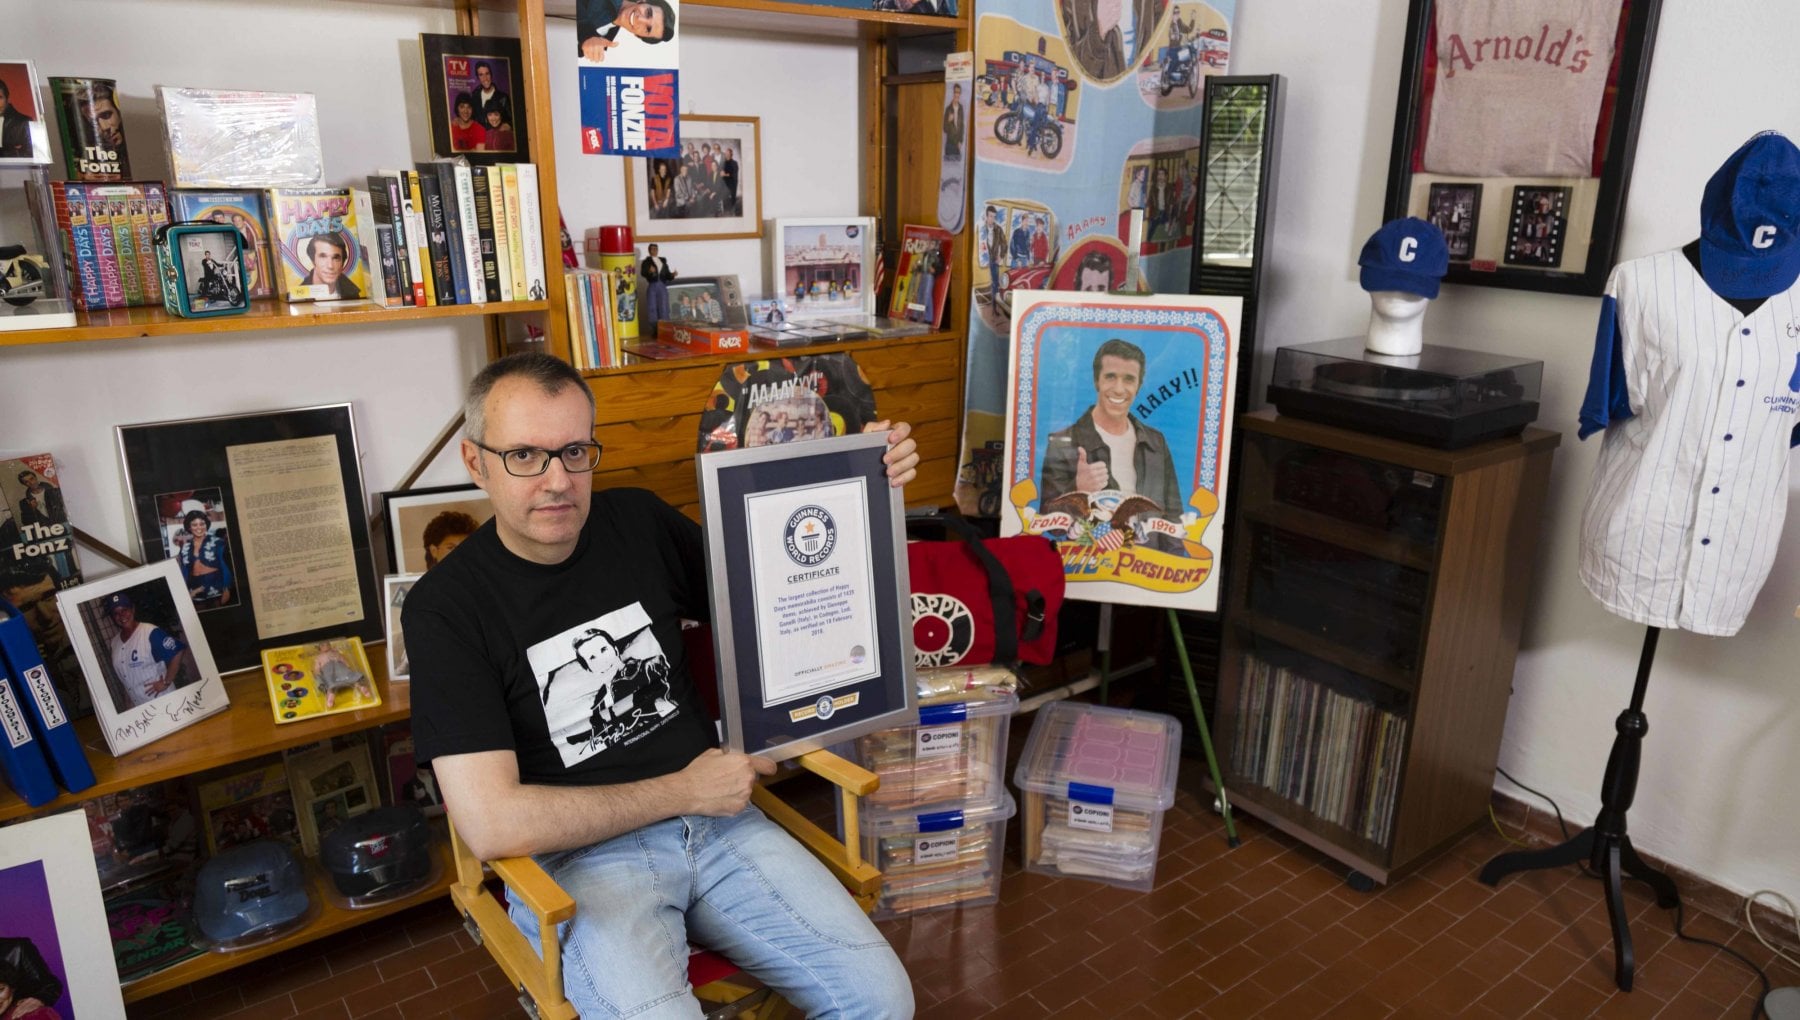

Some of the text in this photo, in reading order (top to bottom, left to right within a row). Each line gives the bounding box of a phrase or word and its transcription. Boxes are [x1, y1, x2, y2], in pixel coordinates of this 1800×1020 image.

[1446, 24, 1593, 78] Arnold's
[449, 60, 468, 71] TV
[620, 76, 647, 151] FONZIE
[643, 73, 675, 150] VOTA
[588, 129, 601, 150] FOX
[85, 145, 117, 161] The
[79, 159, 121, 174] Fonz
[282, 196, 351, 225] HAPPY
[476, 196, 491, 230] HOWARD
[296, 217, 344, 239] DAYS
[1752, 225, 1777, 249] C
[118, 226, 132, 256] DAYS
[139, 225, 152, 255] DAYS
[1398, 236, 1418, 262] C
[77, 228, 99, 296] HAPPY DAYS
[101, 228, 121, 295] HAPPY DAYS
[485, 261, 496, 280] GRAY
[1136, 368, 1199, 420] AAAY!!
[790, 508, 829, 528] GUINNESS
[1031, 516, 1176, 534] FONZ 1976
[21, 522, 65, 541] The
[12, 538, 69, 560] Fonz
[786, 528, 834, 564] WORLD RECORDS
[787, 567, 840, 583] CERTIFICATE
[1112, 552, 1209, 584] PRESIDENT
[788, 592, 804, 601] largest
[131, 650, 138, 662] C
[794, 666, 823, 677] OFFICIALLY
[932, 732, 959, 741] COPIONI
[1084, 808, 1110, 816] COPIONI
[930, 840, 956, 849] COPIONI
